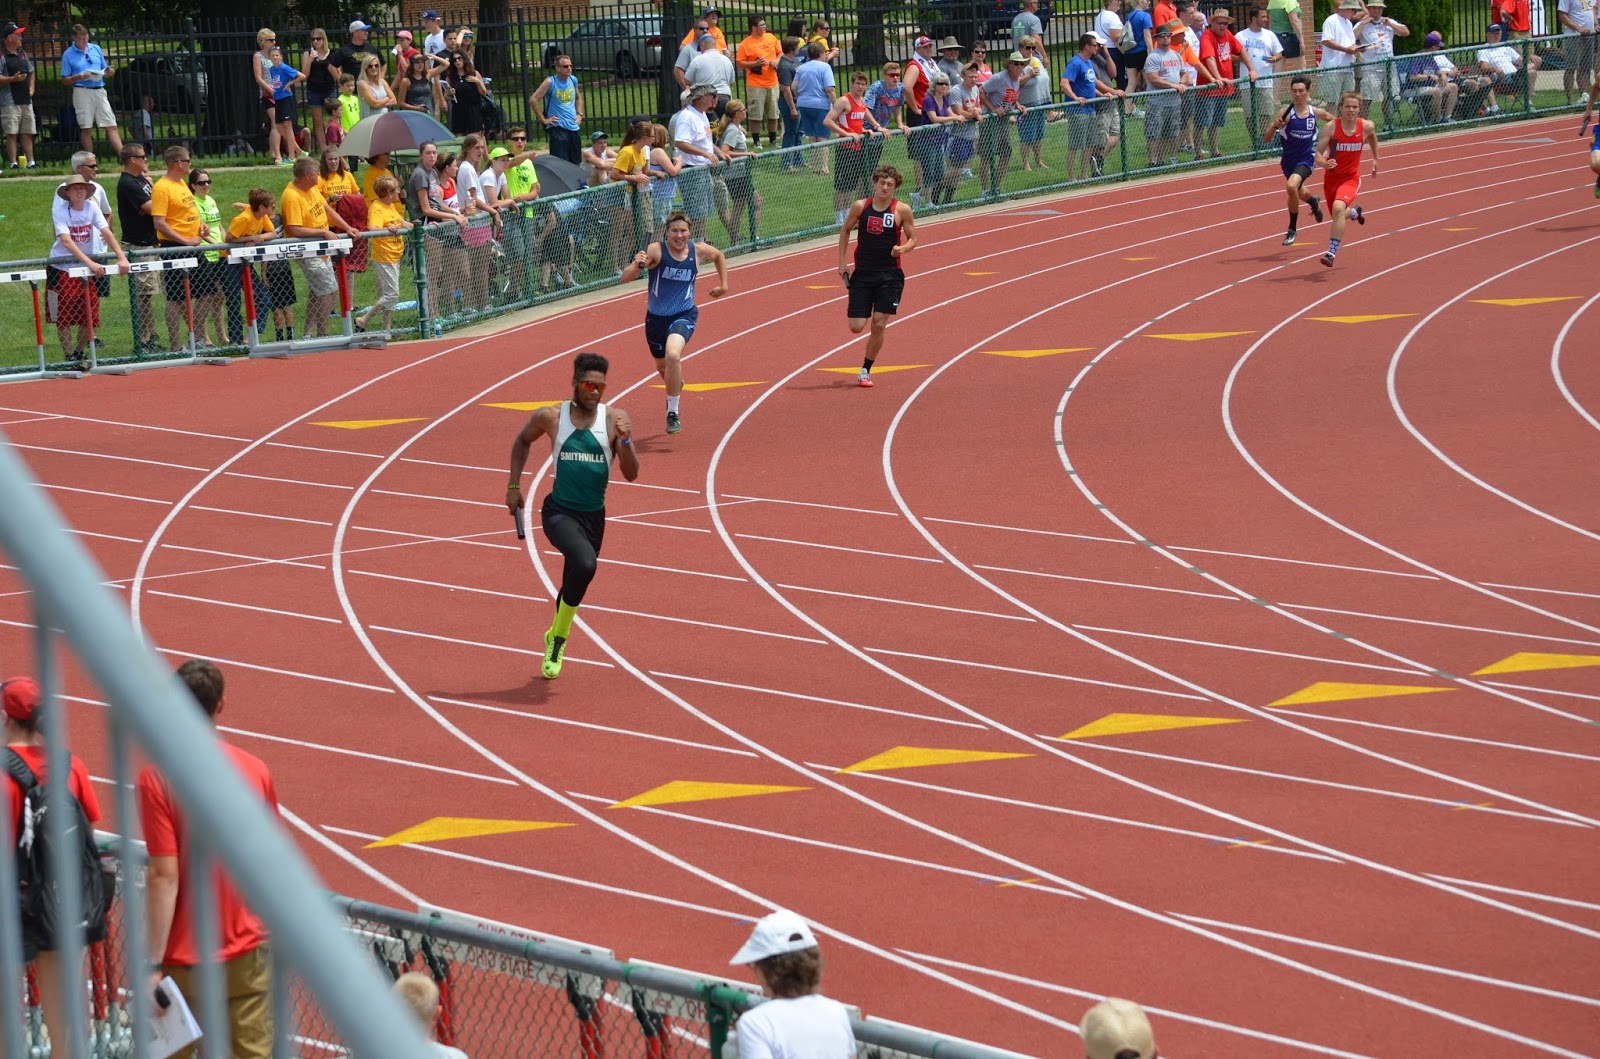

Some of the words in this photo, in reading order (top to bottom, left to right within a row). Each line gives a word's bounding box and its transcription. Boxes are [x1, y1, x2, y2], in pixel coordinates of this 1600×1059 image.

[1335, 142, 1362, 152] ASTWOOD
[867, 215, 884, 235] B
[884, 214, 893, 227] 6
[279, 244, 306, 253] UCS
[130, 263, 149, 272] CS
[560, 451, 605, 463] SMITHVILLE
[467, 945, 497, 967] OHIO
[500, 955, 535, 979] STATE
